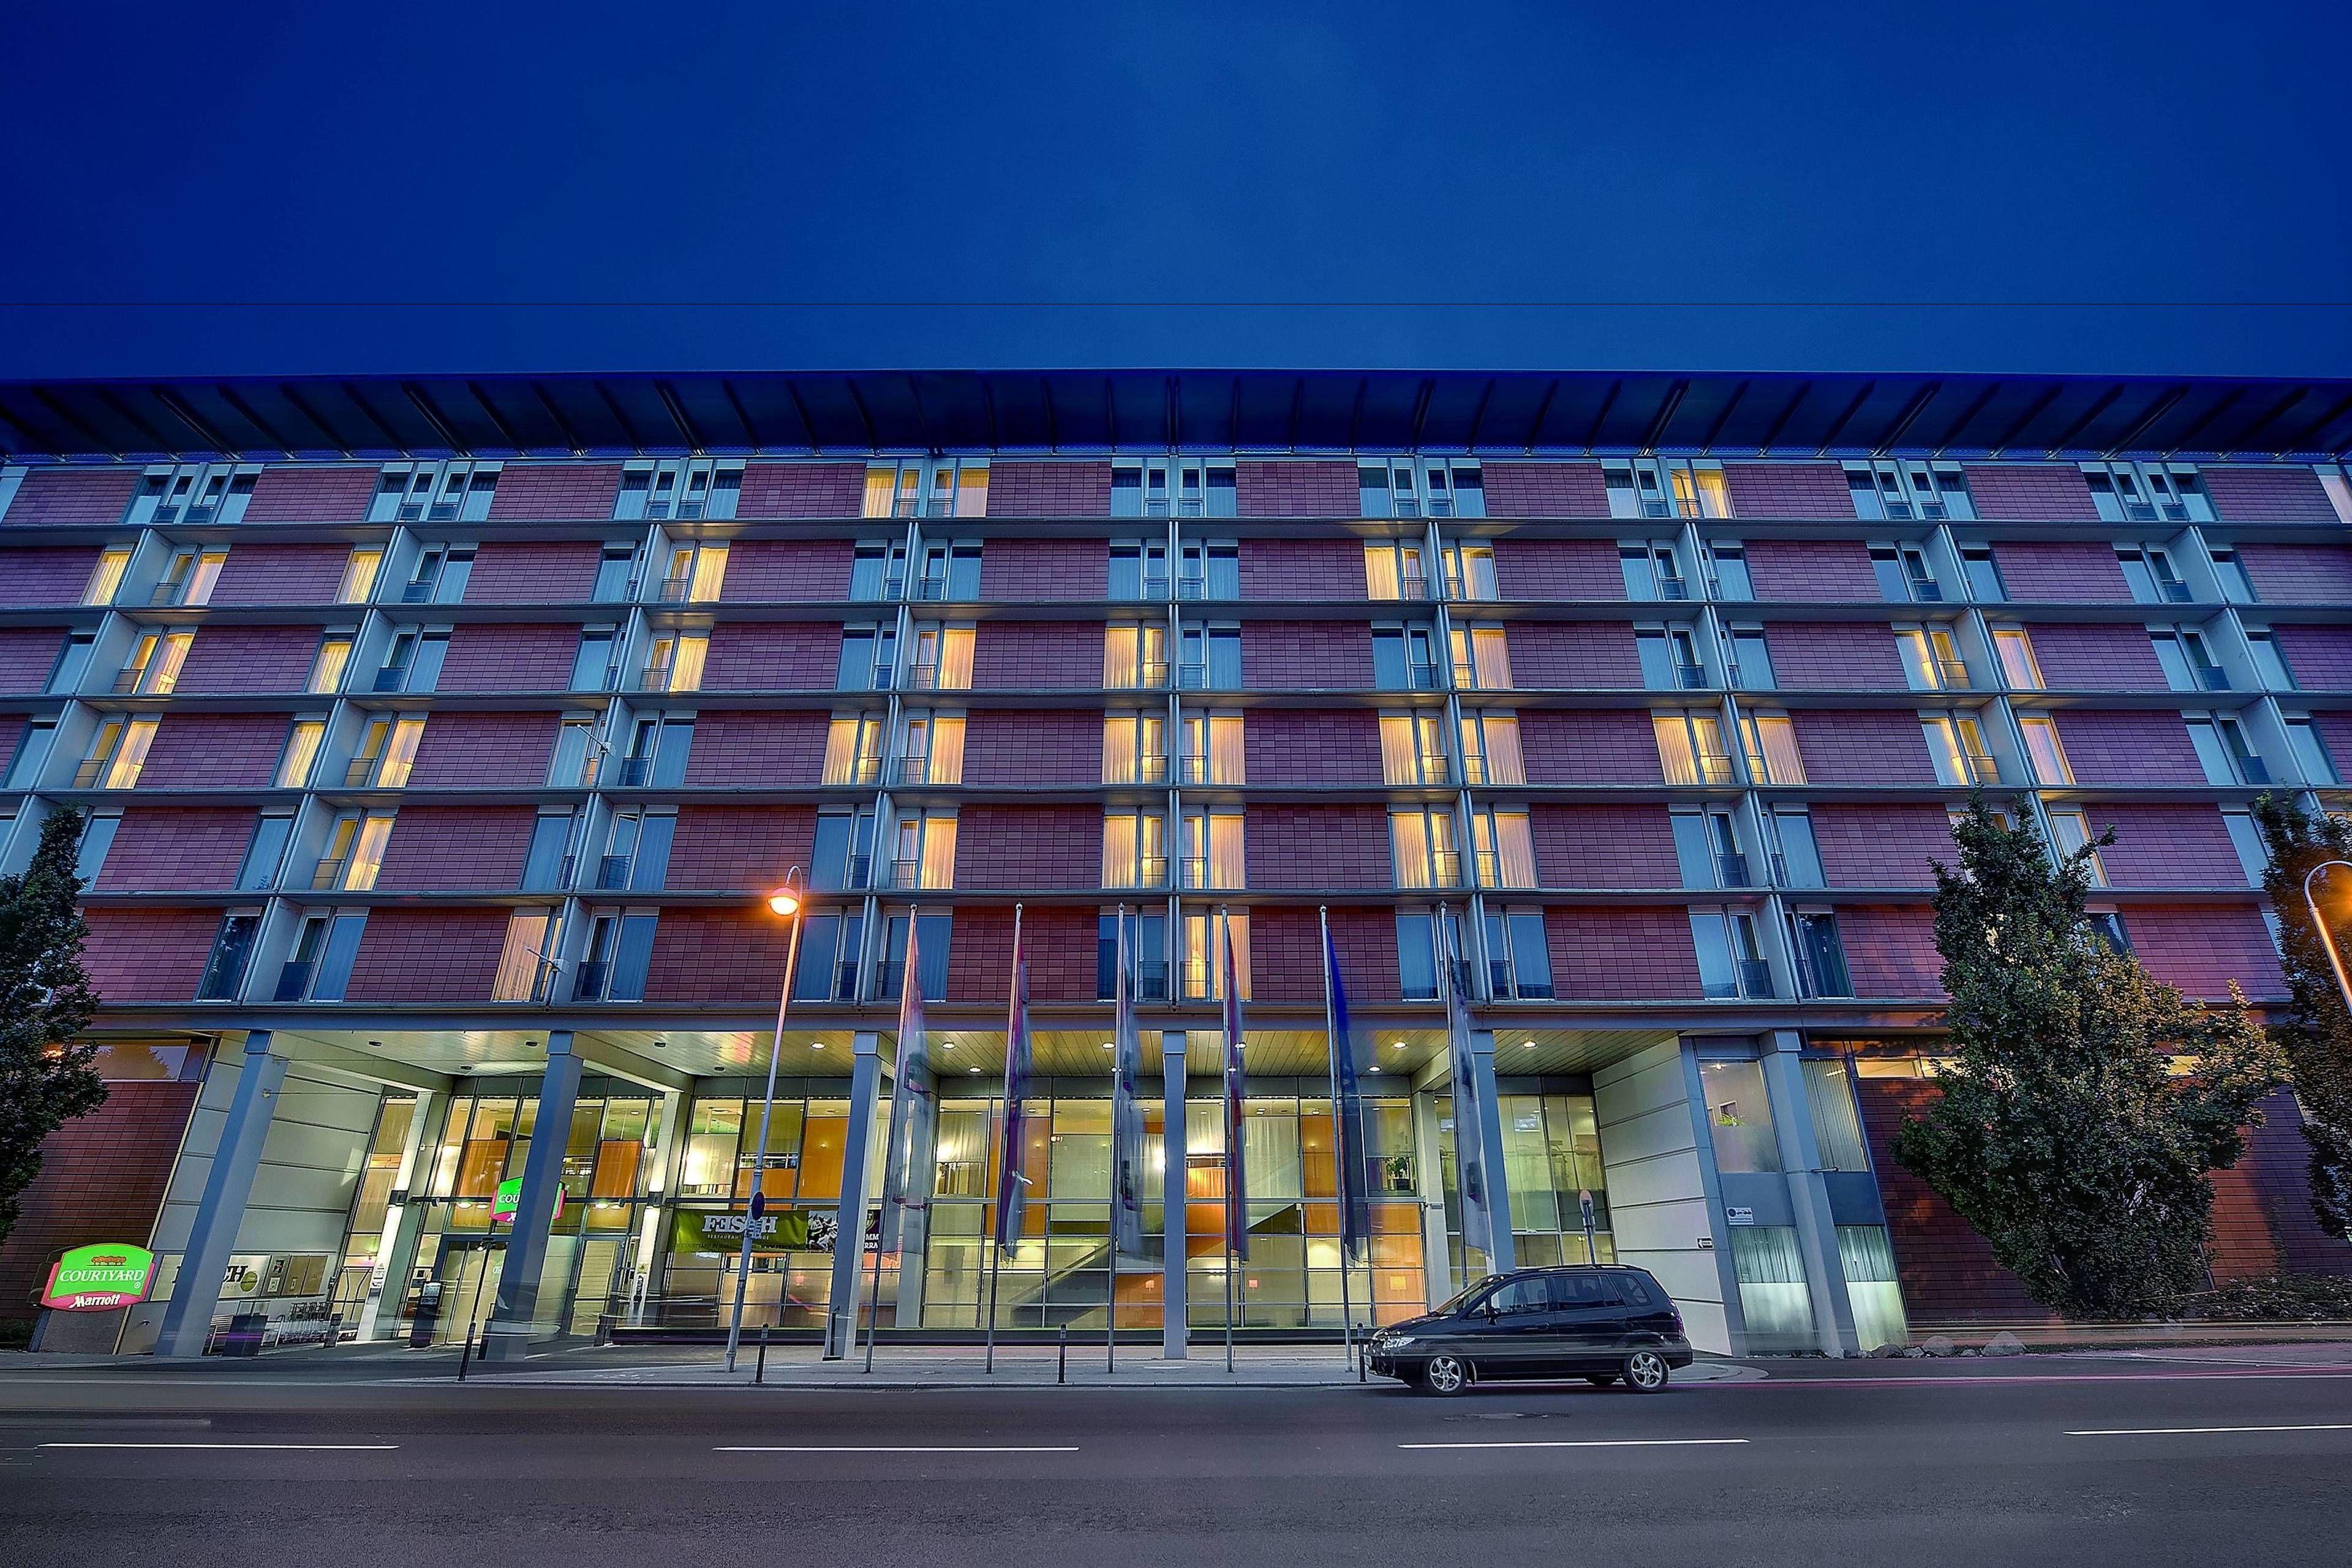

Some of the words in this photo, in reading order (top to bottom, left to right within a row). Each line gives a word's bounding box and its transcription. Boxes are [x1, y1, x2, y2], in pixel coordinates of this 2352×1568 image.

[702, 1215, 778, 1234] FESH
[59, 1270, 145, 1282] COURTYARD
[69, 1295, 121, 1309] Marriott
